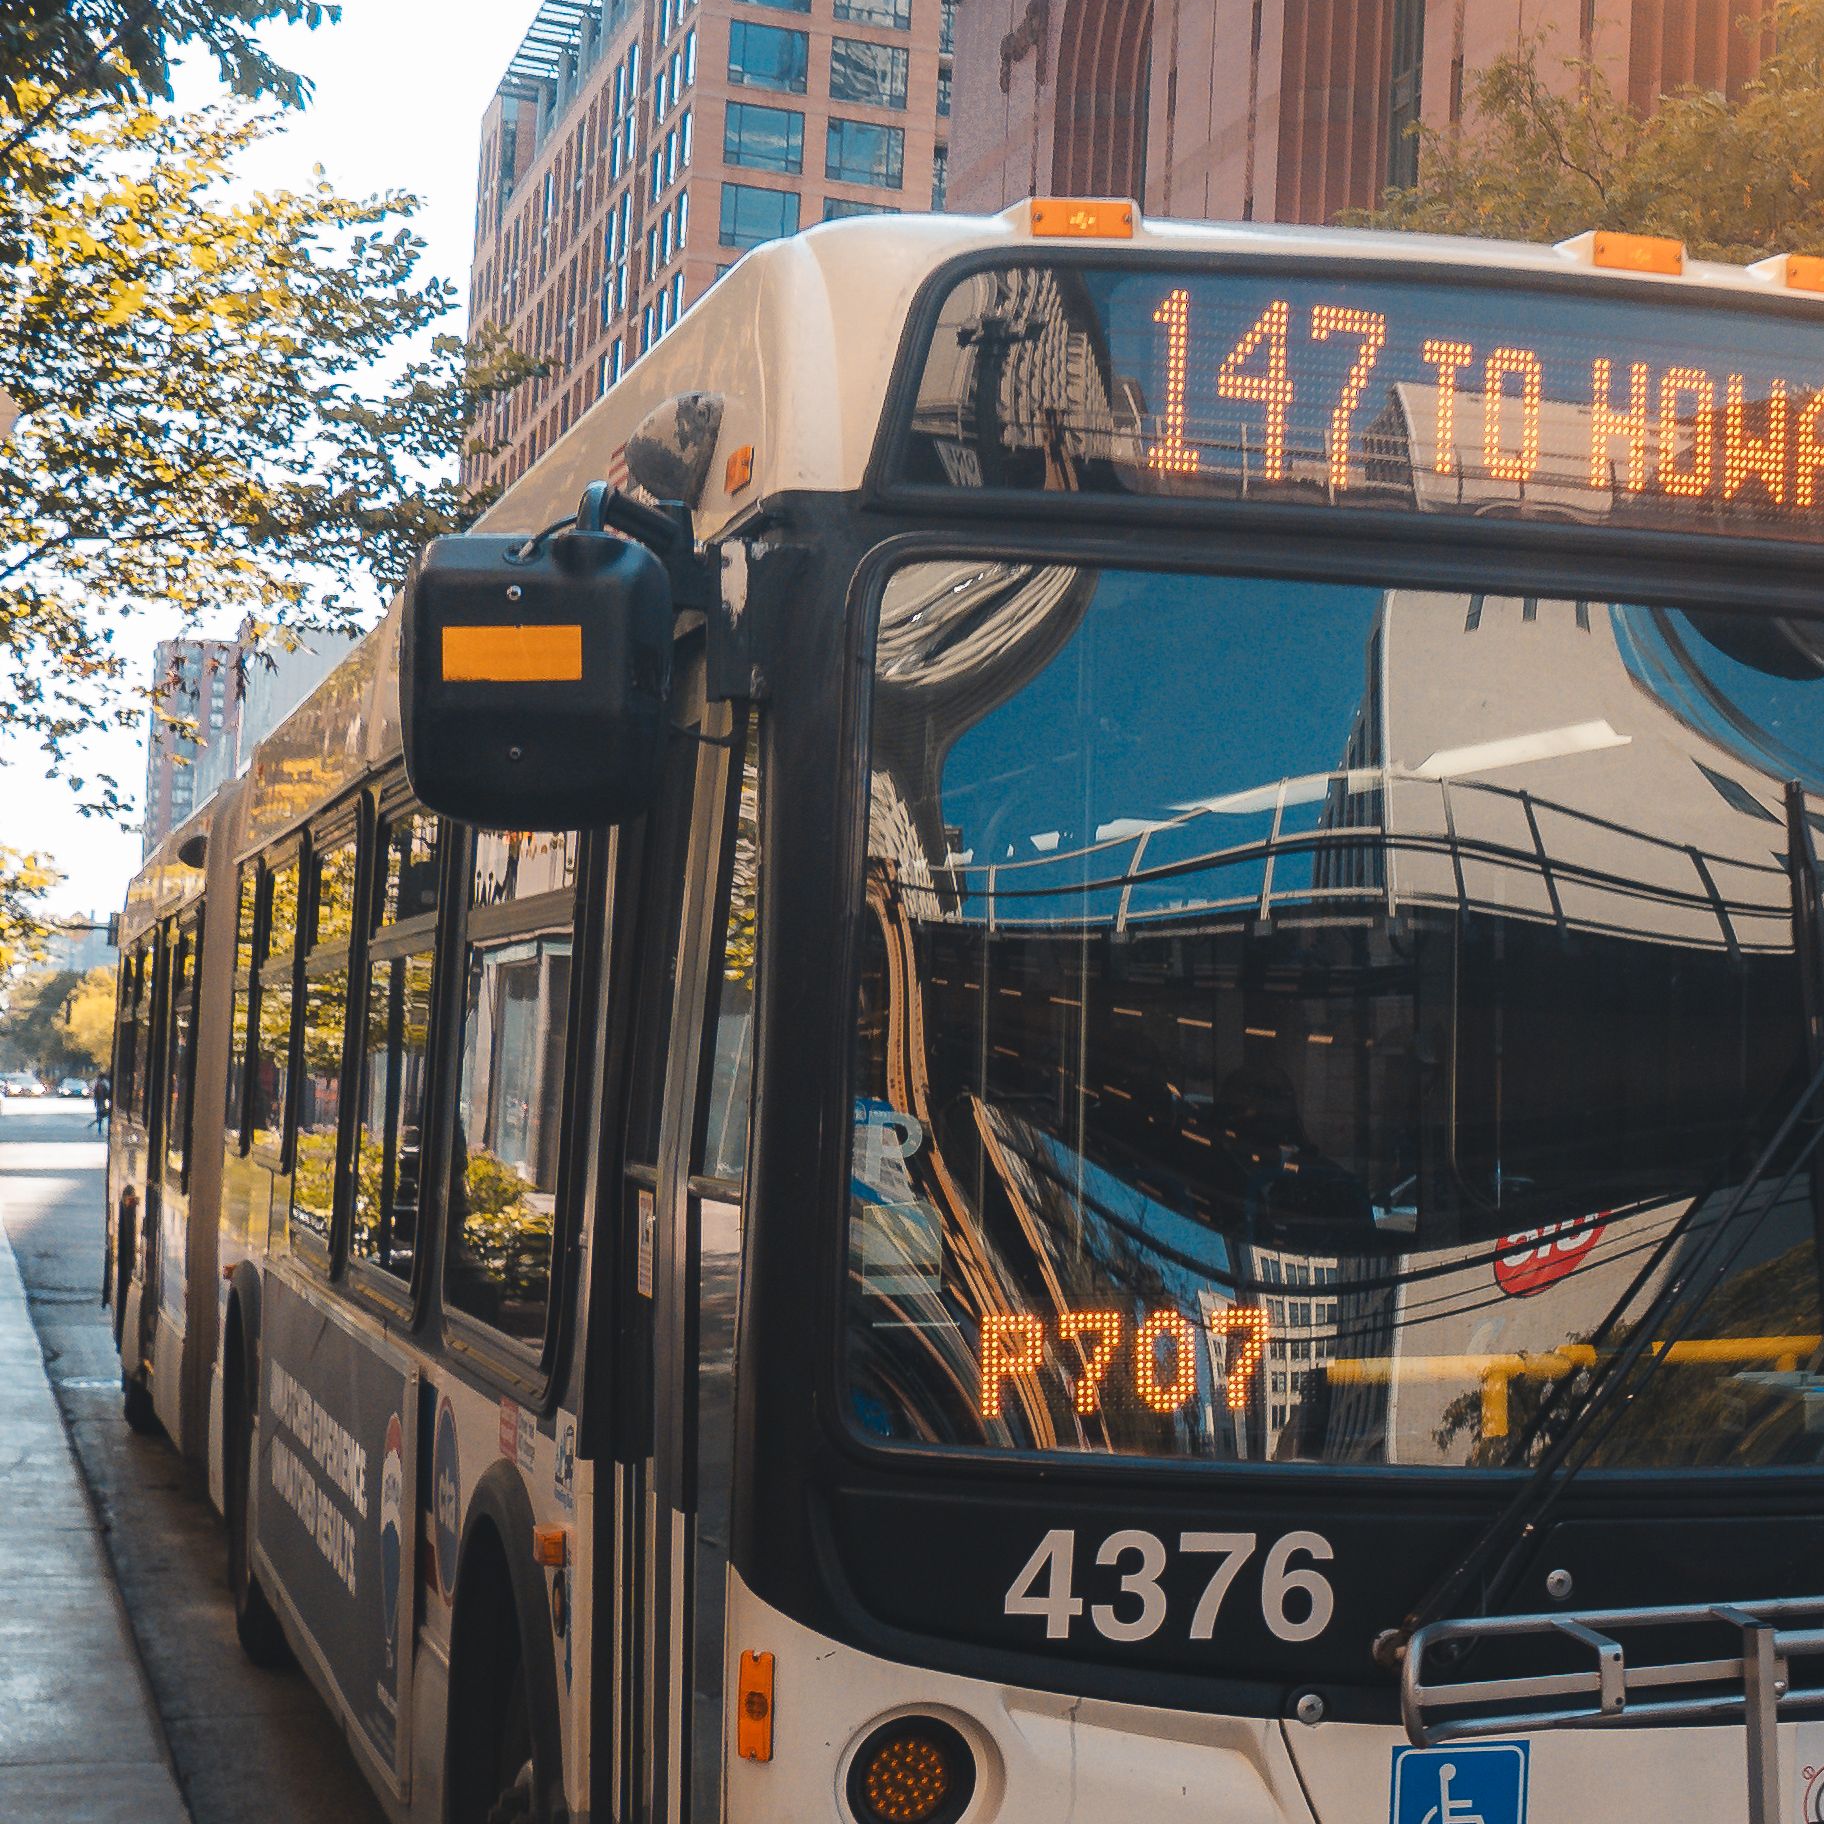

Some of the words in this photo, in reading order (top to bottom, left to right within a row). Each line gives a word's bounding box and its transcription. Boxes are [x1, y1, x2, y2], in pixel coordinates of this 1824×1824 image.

[1148, 287, 1387, 488] 147
[1422, 337, 1543, 481] TO
[979, 1307, 1270, 1418] P707
[1004, 1529, 1335, 1642] 4376
